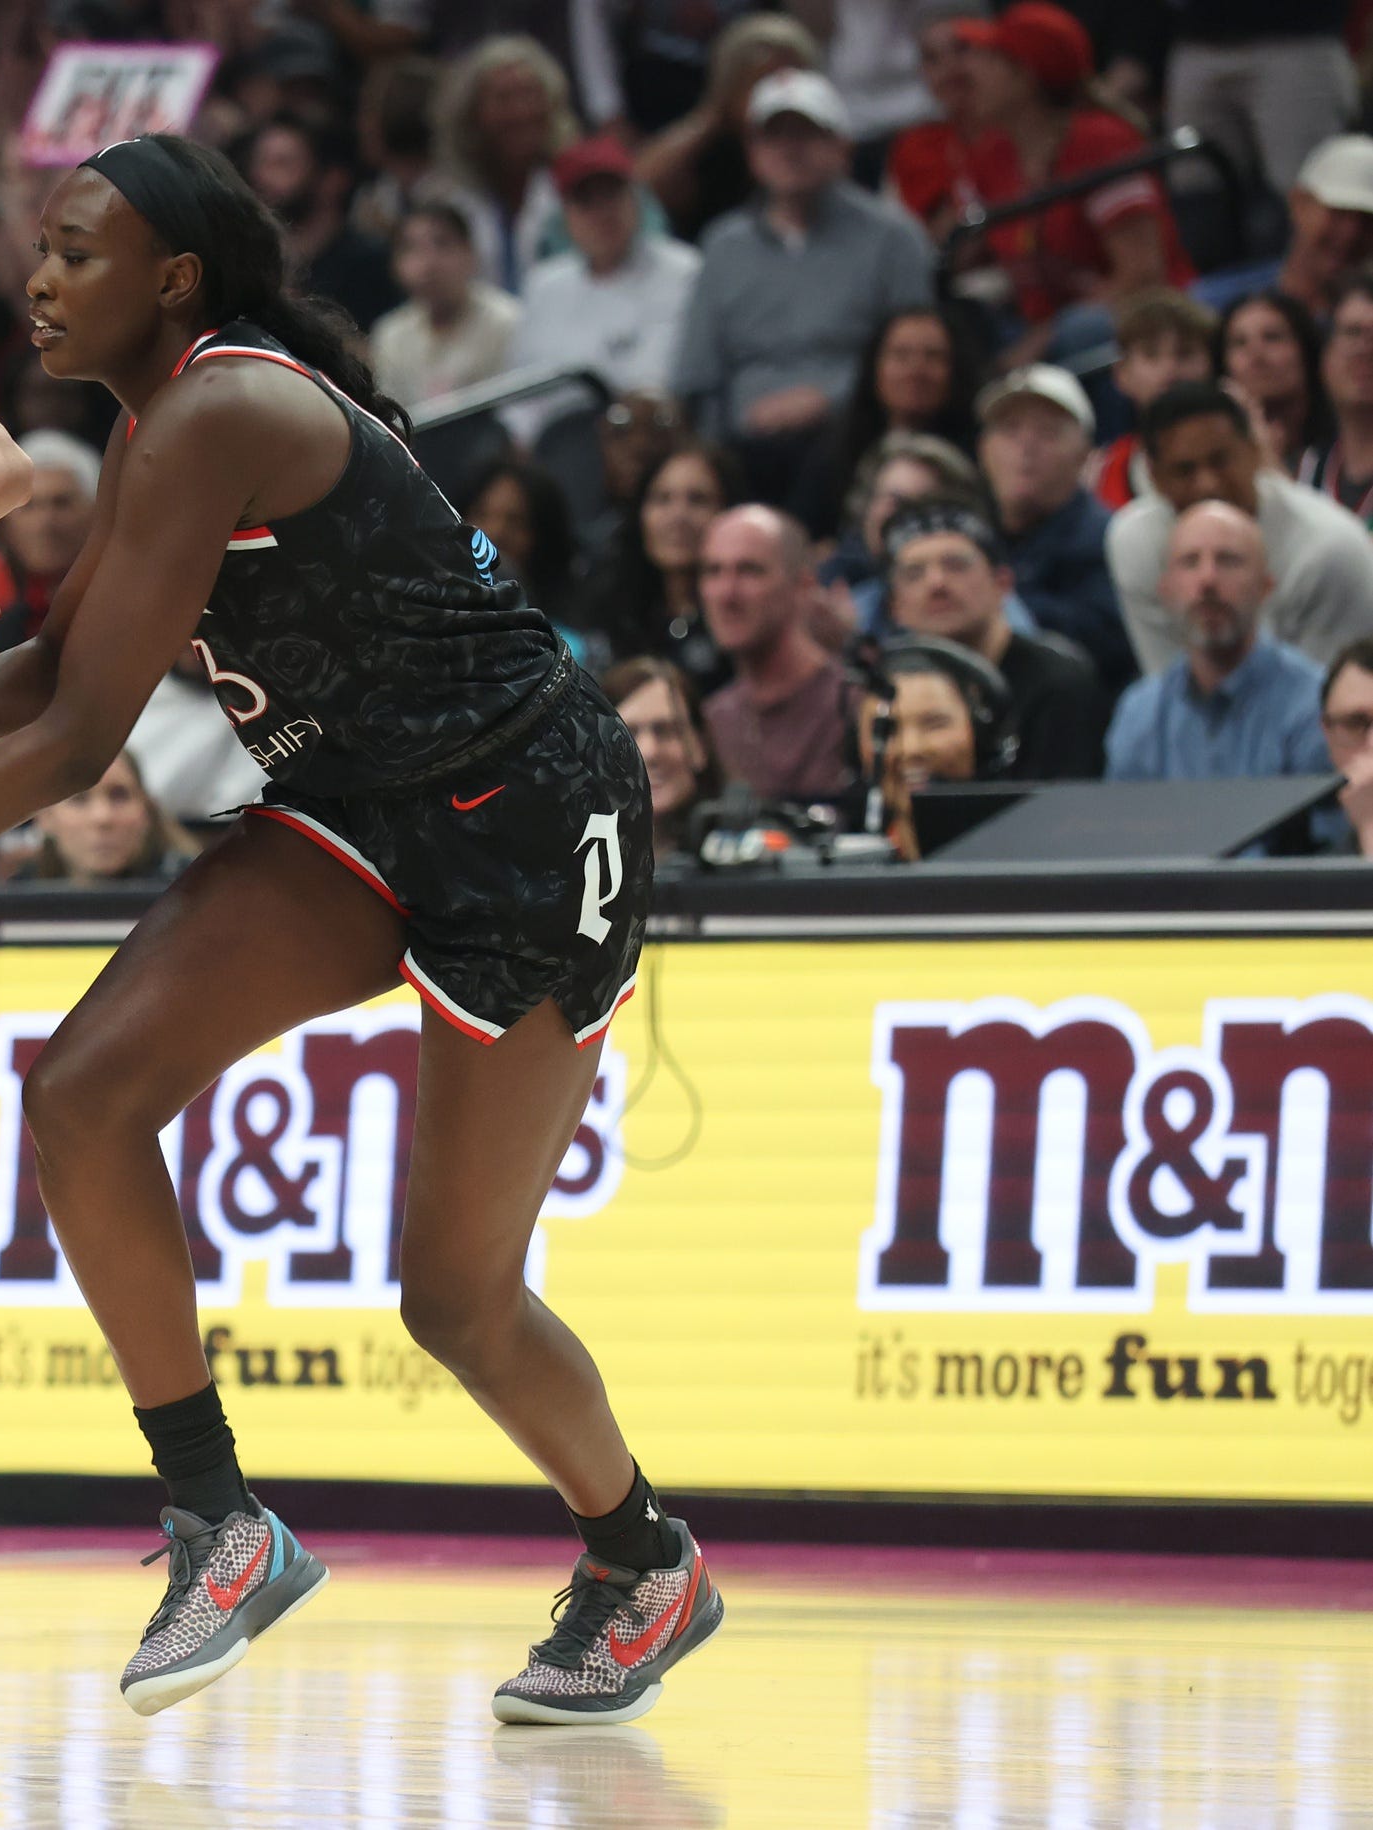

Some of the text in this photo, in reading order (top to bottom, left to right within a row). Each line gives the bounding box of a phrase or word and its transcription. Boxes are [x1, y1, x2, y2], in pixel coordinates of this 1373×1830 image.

[205, 1326, 343, 1386] fun
[855, 1330, 920, 1400] it's
[934, 1349, 1085, 1400] more
[1102, 1333, 1277, 1401] fun
